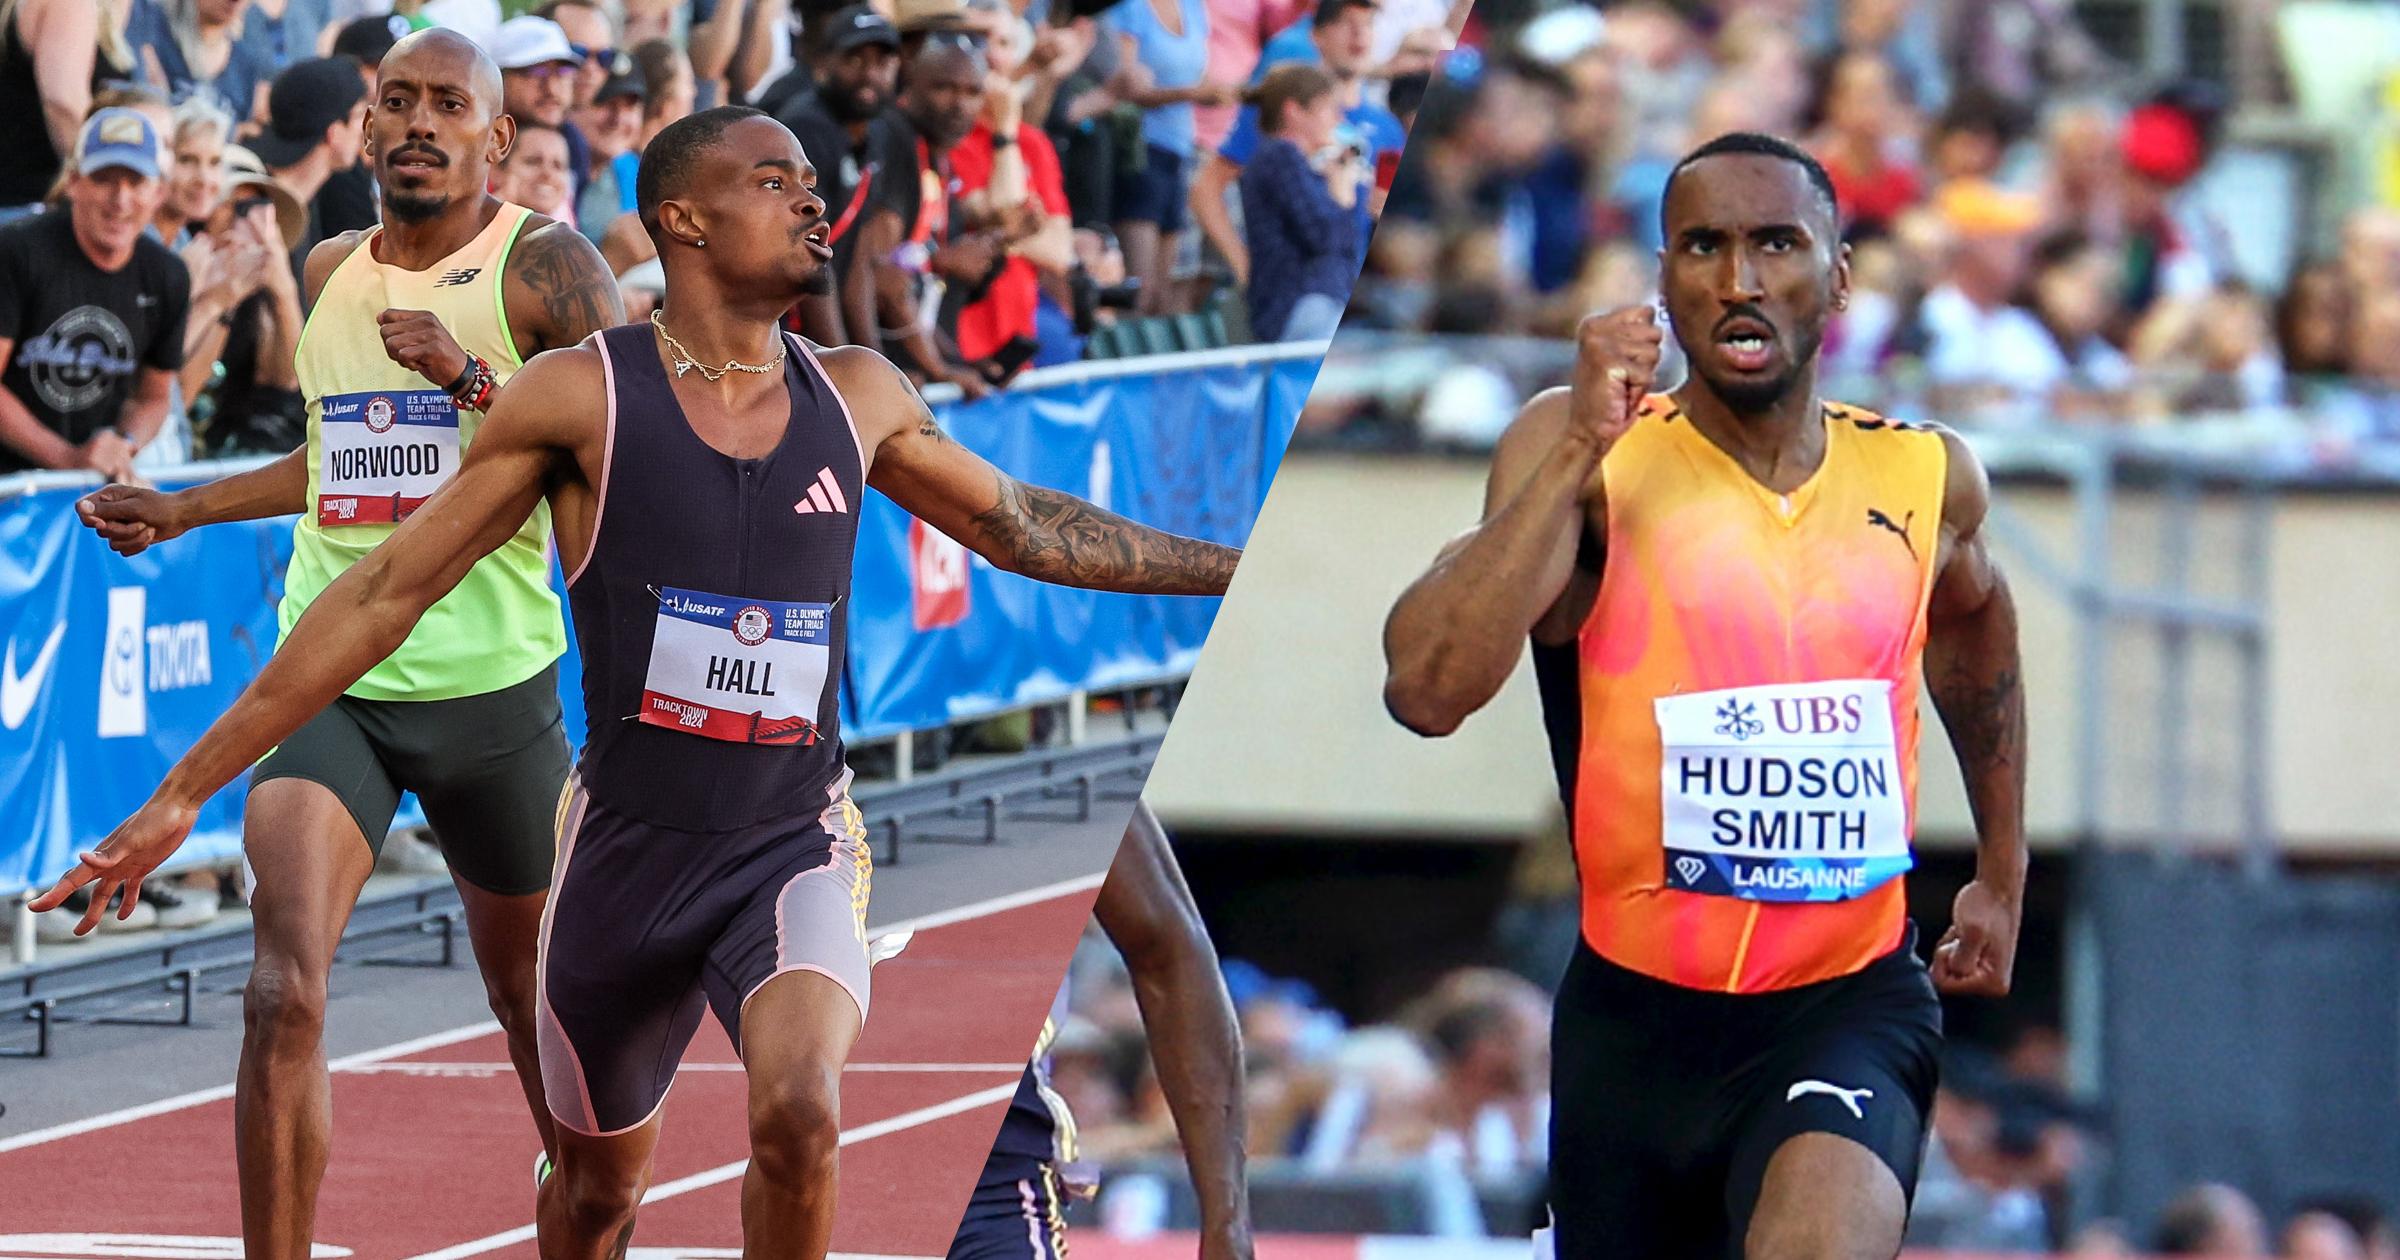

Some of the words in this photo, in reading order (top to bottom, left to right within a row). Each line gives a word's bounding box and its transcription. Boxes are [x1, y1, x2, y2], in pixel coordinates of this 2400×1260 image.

[337, 403, 359, 414] USATF
[407, 395, 420, 404] U.S.
[421, 395, 451, 404] OLYMPIC
[407, 404, 426, 413] TEAM
[427, 404, 452, 413] TRIALS
[331, 443, 440, 482] NORWOOD
[688, 602, 725, 616] USATF
[785, 608, 798, 619] U.S.
[799, 609, 825, 619] OLYMPIC
[784, 619, 803, 629] TEAM
[804, 619, 824, 630] TRIALS
[784, 629, 799, 637] TRACK
[146, 620, 212, 692] TOYOTA
[706, 655, 775, 697] HALL
[652, 698, 709, 720] TRACKTOWN
[1770, 694, 1863, 734] UBS
[679, 713, 704, 729] 2024
[1680, 756, 1888, 799] HUDSON
[1711, 808, 1867, 851] SMITH
[1733, 864, 1867, 889] LAUSANNE
